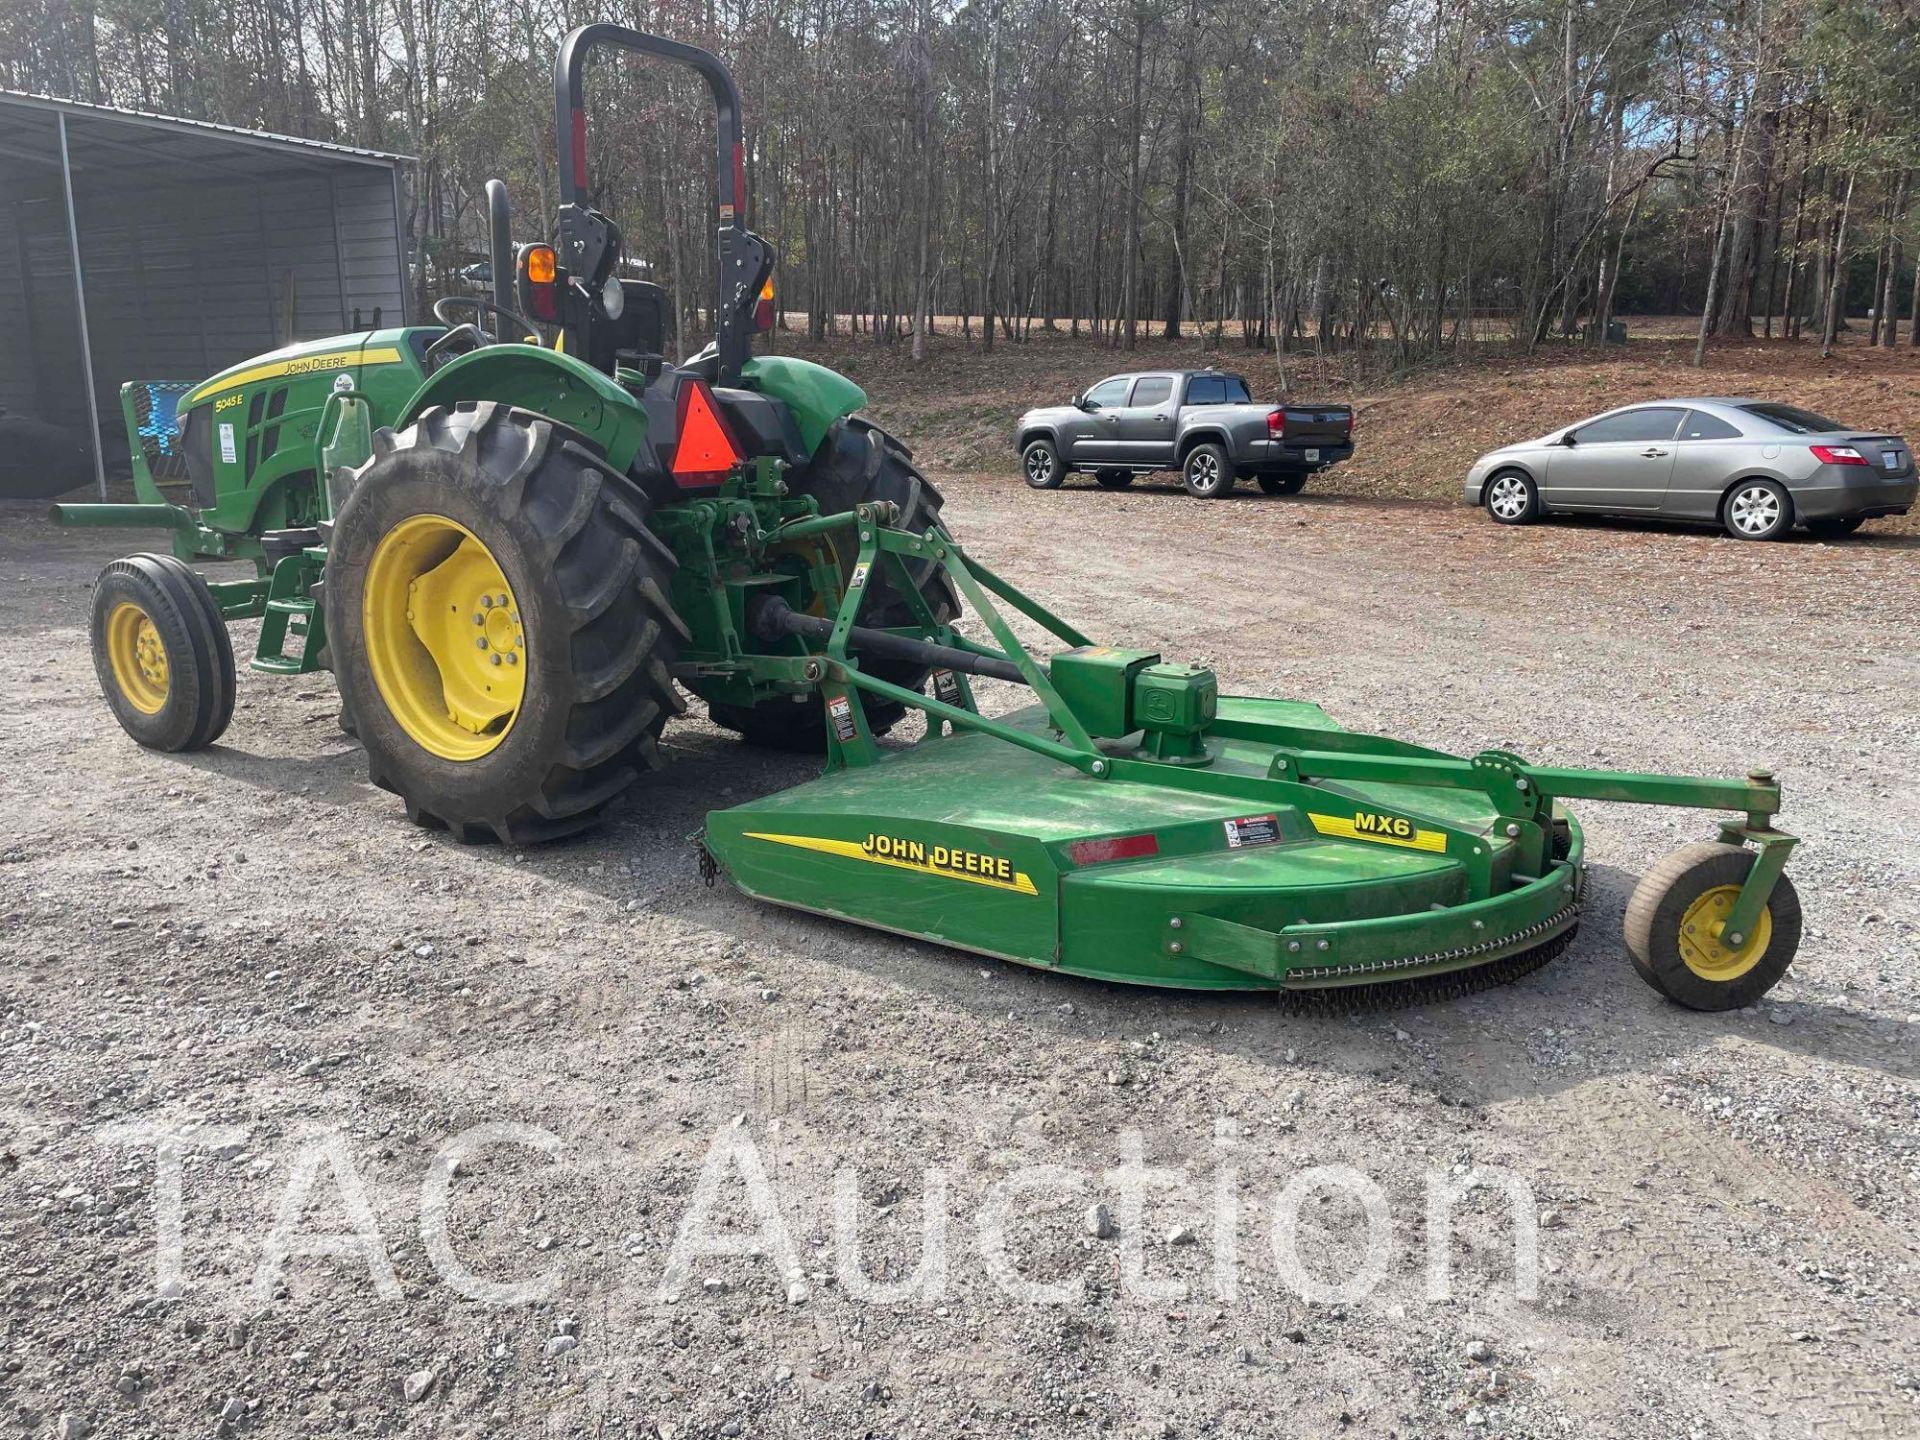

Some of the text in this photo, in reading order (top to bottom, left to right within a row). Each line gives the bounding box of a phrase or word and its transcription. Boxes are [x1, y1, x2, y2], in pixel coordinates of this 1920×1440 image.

[284, 356, 347, 375] JOHN DEERE
[1355, 812, 1412, 838] MX6
[862, 833, 1013, 881] JOHN DEERE
